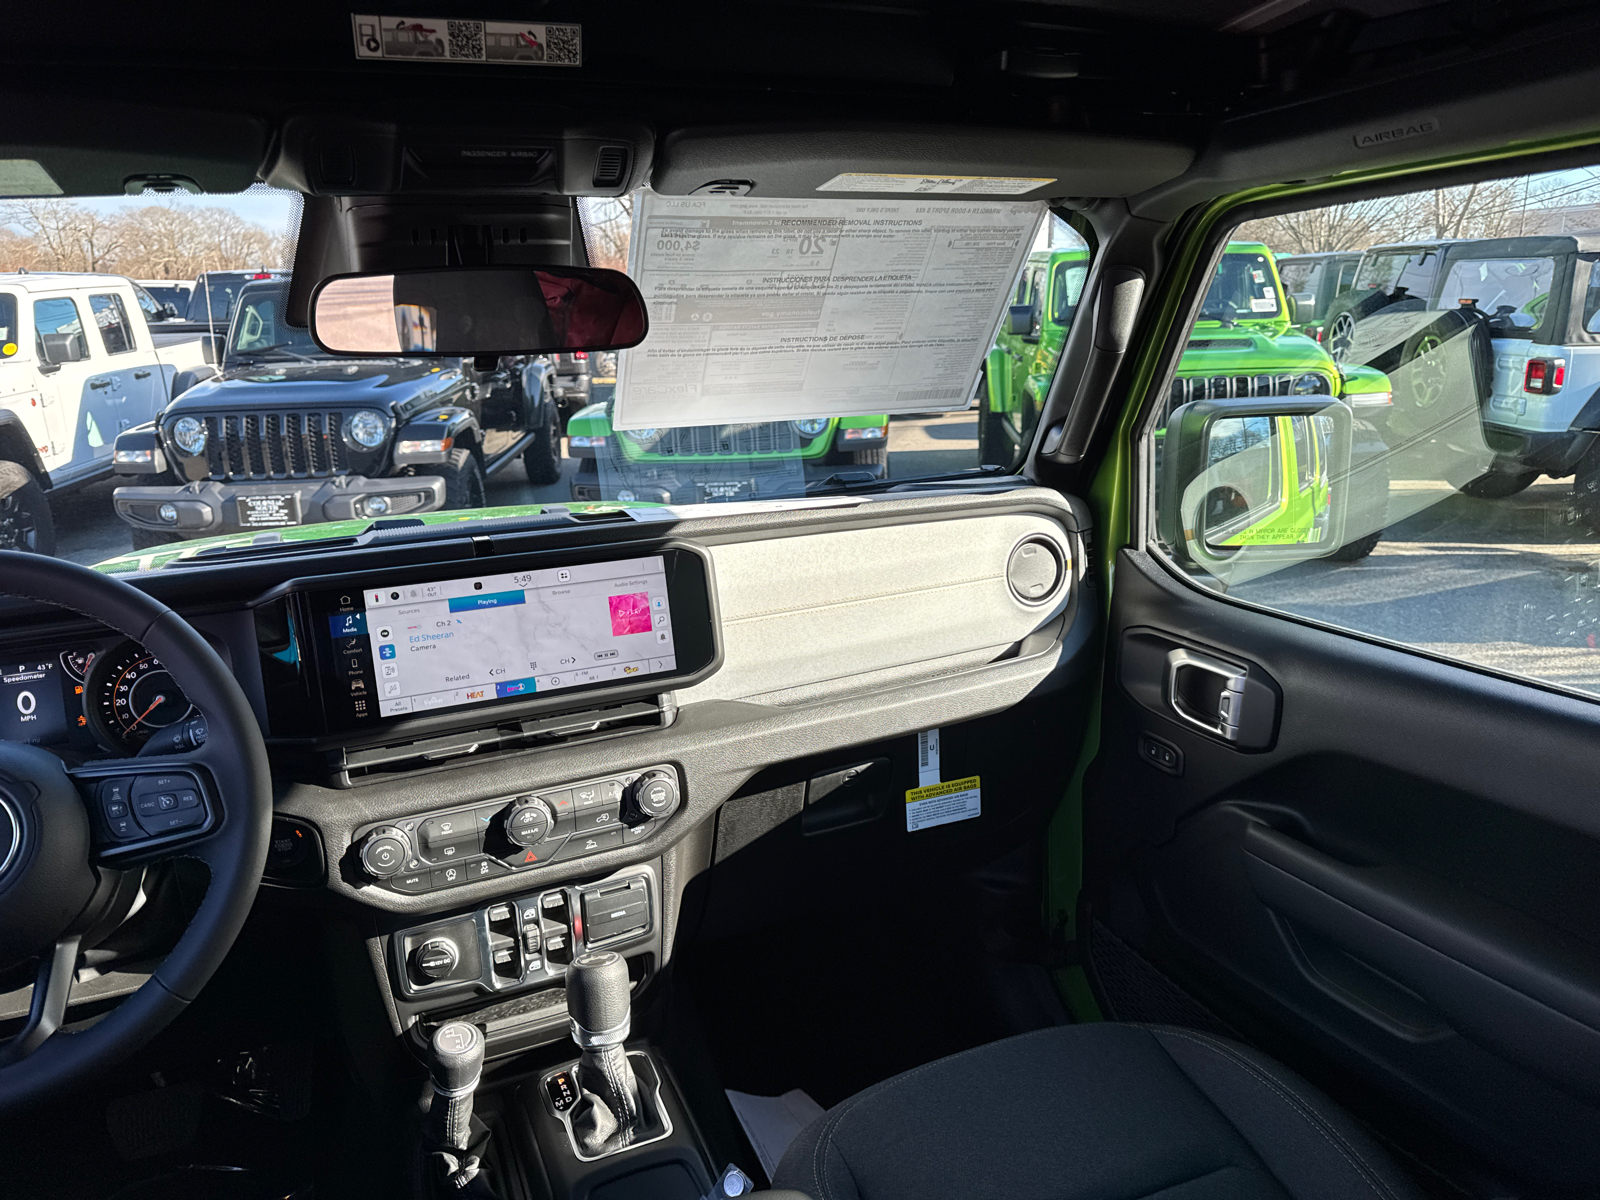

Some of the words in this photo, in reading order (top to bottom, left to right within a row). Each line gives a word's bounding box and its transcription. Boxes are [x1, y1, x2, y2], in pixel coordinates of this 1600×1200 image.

[1362, 122, 1433, 145] AIRBAG
[460, 150, 508, 158] PASSENGER
[509, 150, 539, 158] AIRBAG
[838, 333, 866, 341] DÉPOSE
[513, 574, 532, 584] 5:49
[628, 579, 648, 587] Settings
[477, 598, 498, 606] Playing
[398, 608, 421, 616] Sources
[435, 620, 446, 628] Ch
[409, 635, 421, 644] Ed
[421, 632, 455, 642] Sheeran
[410, 643, 437, 652] Camera
[18, 665, 26, 673] P
[37, 663, 53, 671] 43°F
[3, 673, 46, 684] Speedometer
[125, 671, 137, 680] 40
[445, 673, 470, 683] Related
[466, 690, 485, 700] HEAT
[16, 690, 36, 715] 0
[115, 698, 127, 707] 20
[20, 714, 37, 723] MPH
[923, 784, 945, 793] VEHICLE
[951, 778, 977, 787] EQUIPPED
[925, 788, 953, 798] ADVANCED
[140, 801, 155, 809] CANC
[610, 909, 627, 918] MEDIA
[557, 1077, 565, 1085] P
[562, 1089, 571, 1097] N
[554, 1099, 565, 1108] M
[565, 1096, 573, 1104] D
